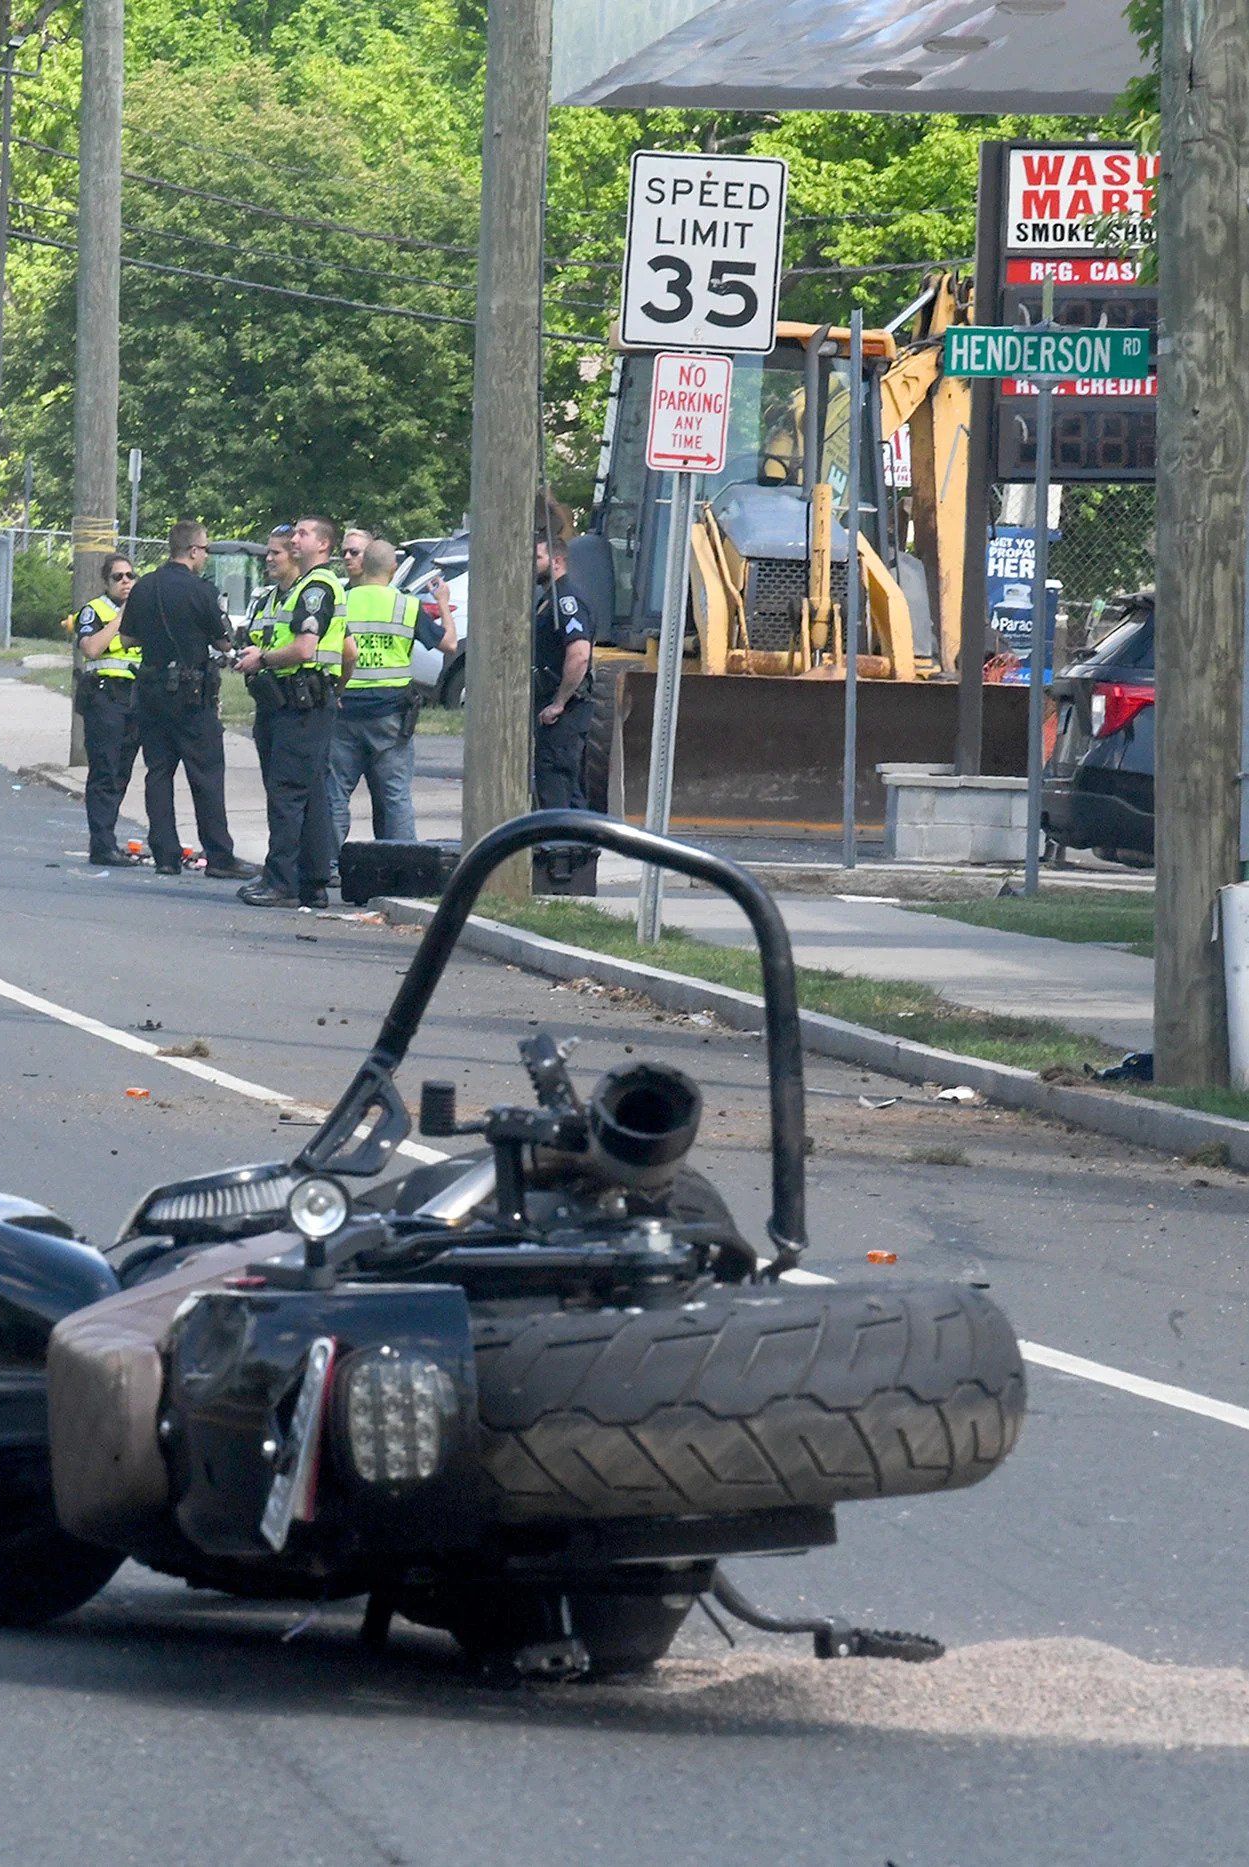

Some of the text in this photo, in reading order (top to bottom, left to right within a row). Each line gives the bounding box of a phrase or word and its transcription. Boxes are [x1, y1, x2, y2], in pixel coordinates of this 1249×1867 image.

[645, 177, 770, 211] SPEED
[1022, 190, 1154, 219] MART
[656, 217, 754, 249] LIMIT
[1016, 222, 1095, 242] SMOKE
[1030, 261, 1080, 281] REG.
[640, 255, 759, 328] 35
[951, 335, 1142, 373] HENDERSON RD
[678, 365, 706, 388] NO
[1075, 376, 1157, 395] CREDIT
[658, 390, 723, 414] PARKING
[674, 416, 703, 431] ANY
[671, 433, 703, 450] TIME
[987, 557, 1036, 579] HER
[999, 616, 1033, 633] Parac
